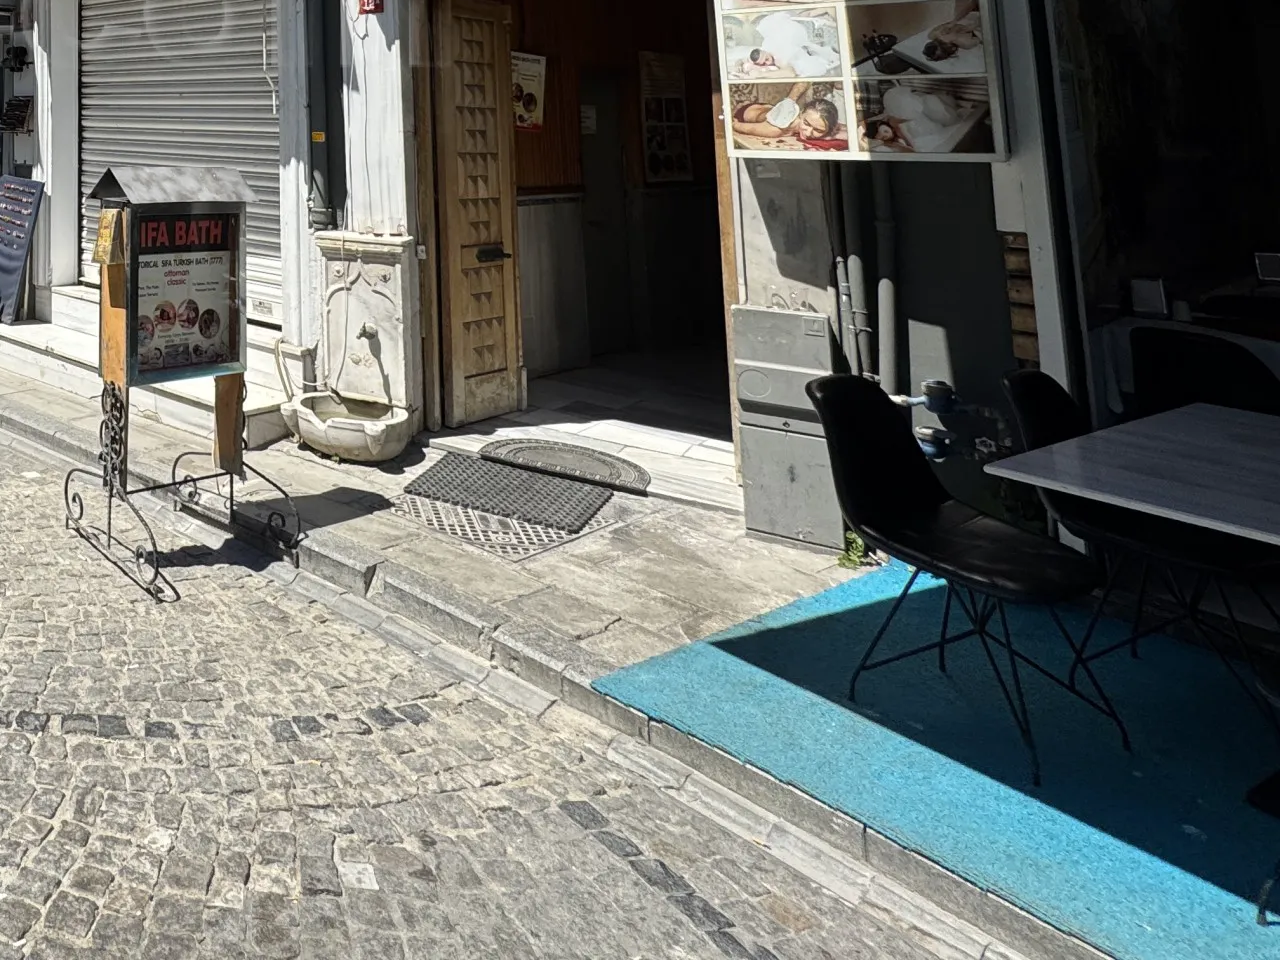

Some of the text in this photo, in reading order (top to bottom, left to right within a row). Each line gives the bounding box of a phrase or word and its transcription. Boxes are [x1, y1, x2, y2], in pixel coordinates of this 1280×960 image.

[175, 220, 222, 246] BATH
[173, 258, 194, 267] TURKISH
[195, 257, 208, 266] BATH
